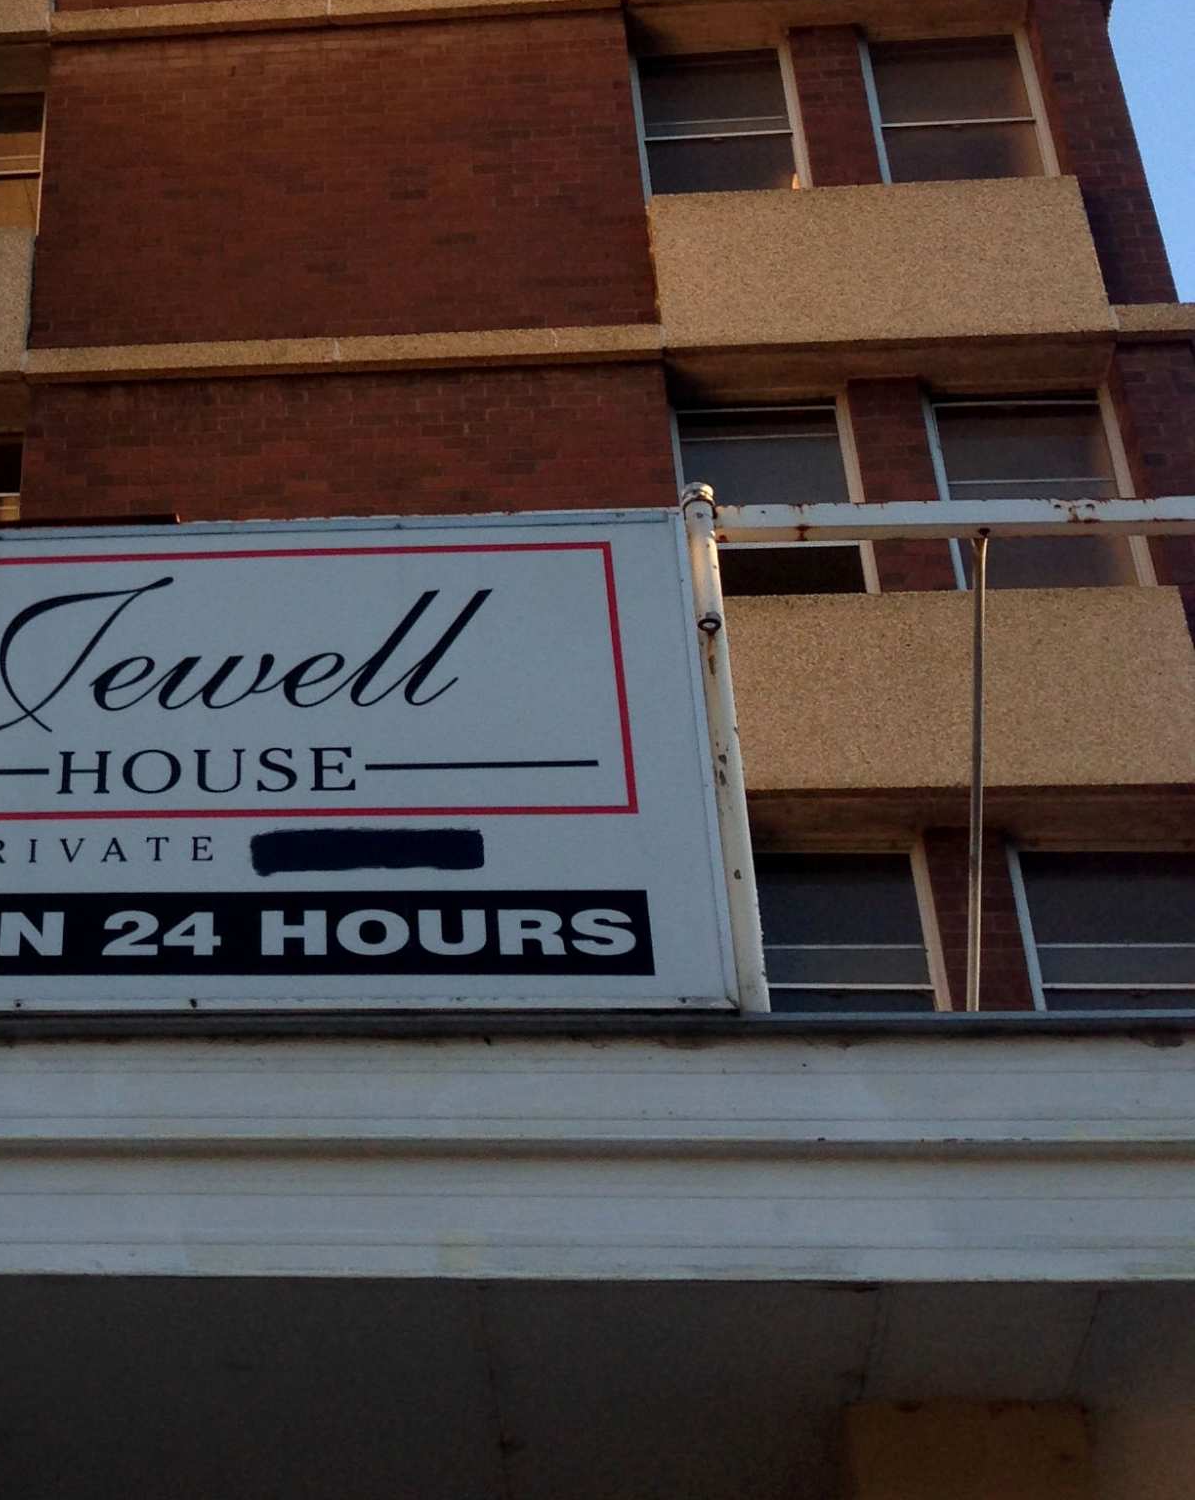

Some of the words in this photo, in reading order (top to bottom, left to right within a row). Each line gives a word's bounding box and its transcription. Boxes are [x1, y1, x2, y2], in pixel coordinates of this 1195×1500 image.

[57, 747, 356, 794] HOUSE
[102, 911, 221, 956] 24
[261, 909, 637, 956] HOURS
